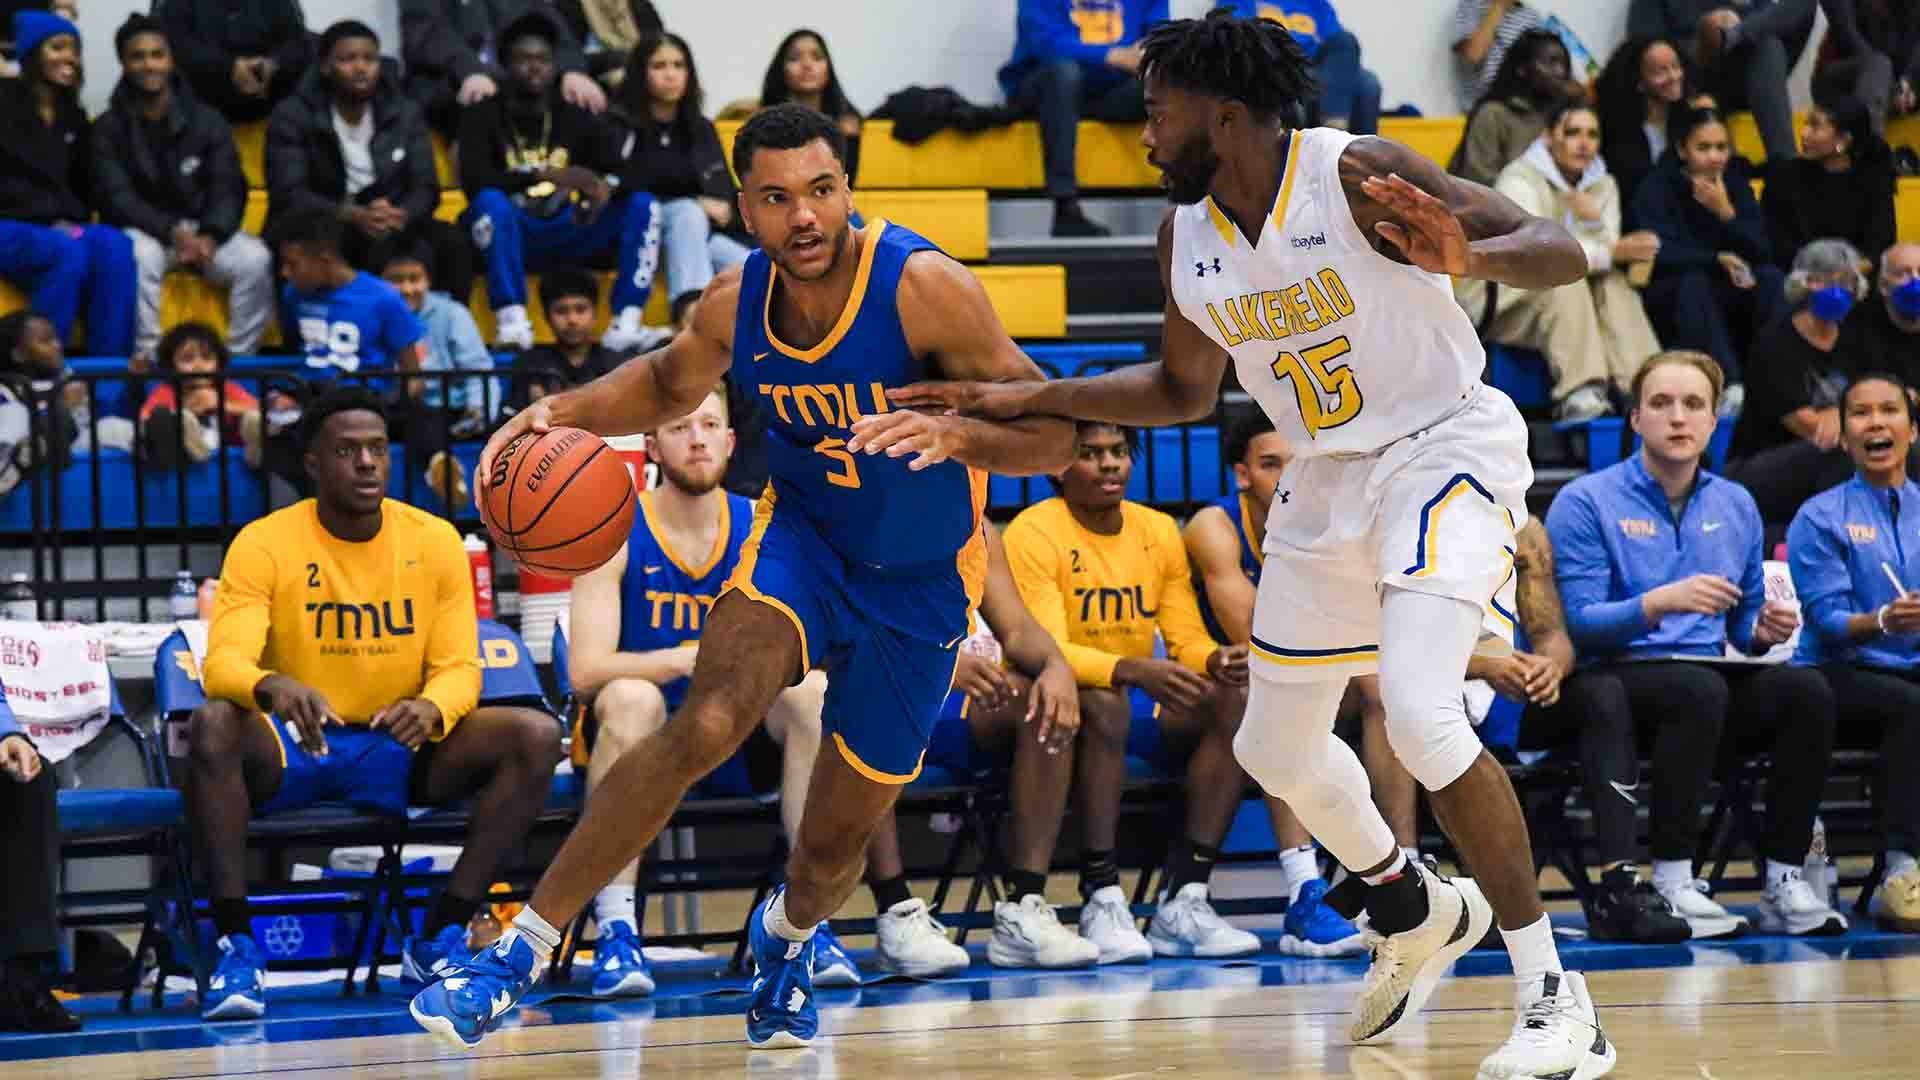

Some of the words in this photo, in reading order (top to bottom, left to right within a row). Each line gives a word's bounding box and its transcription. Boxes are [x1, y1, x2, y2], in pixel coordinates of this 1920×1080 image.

[1205, 267, 1355, 347] LAKEHEAD
[758, 381, 889, 429] TMU
[1270, 335, 1364, 441] 15
[814, 434, 862, 489] 5
[305, 562, 321, 588] 2
[305, 598, 416, 640] TMU
[644, 589, 717, 631] TM
[1073, 584, 1161, 623] TMU
